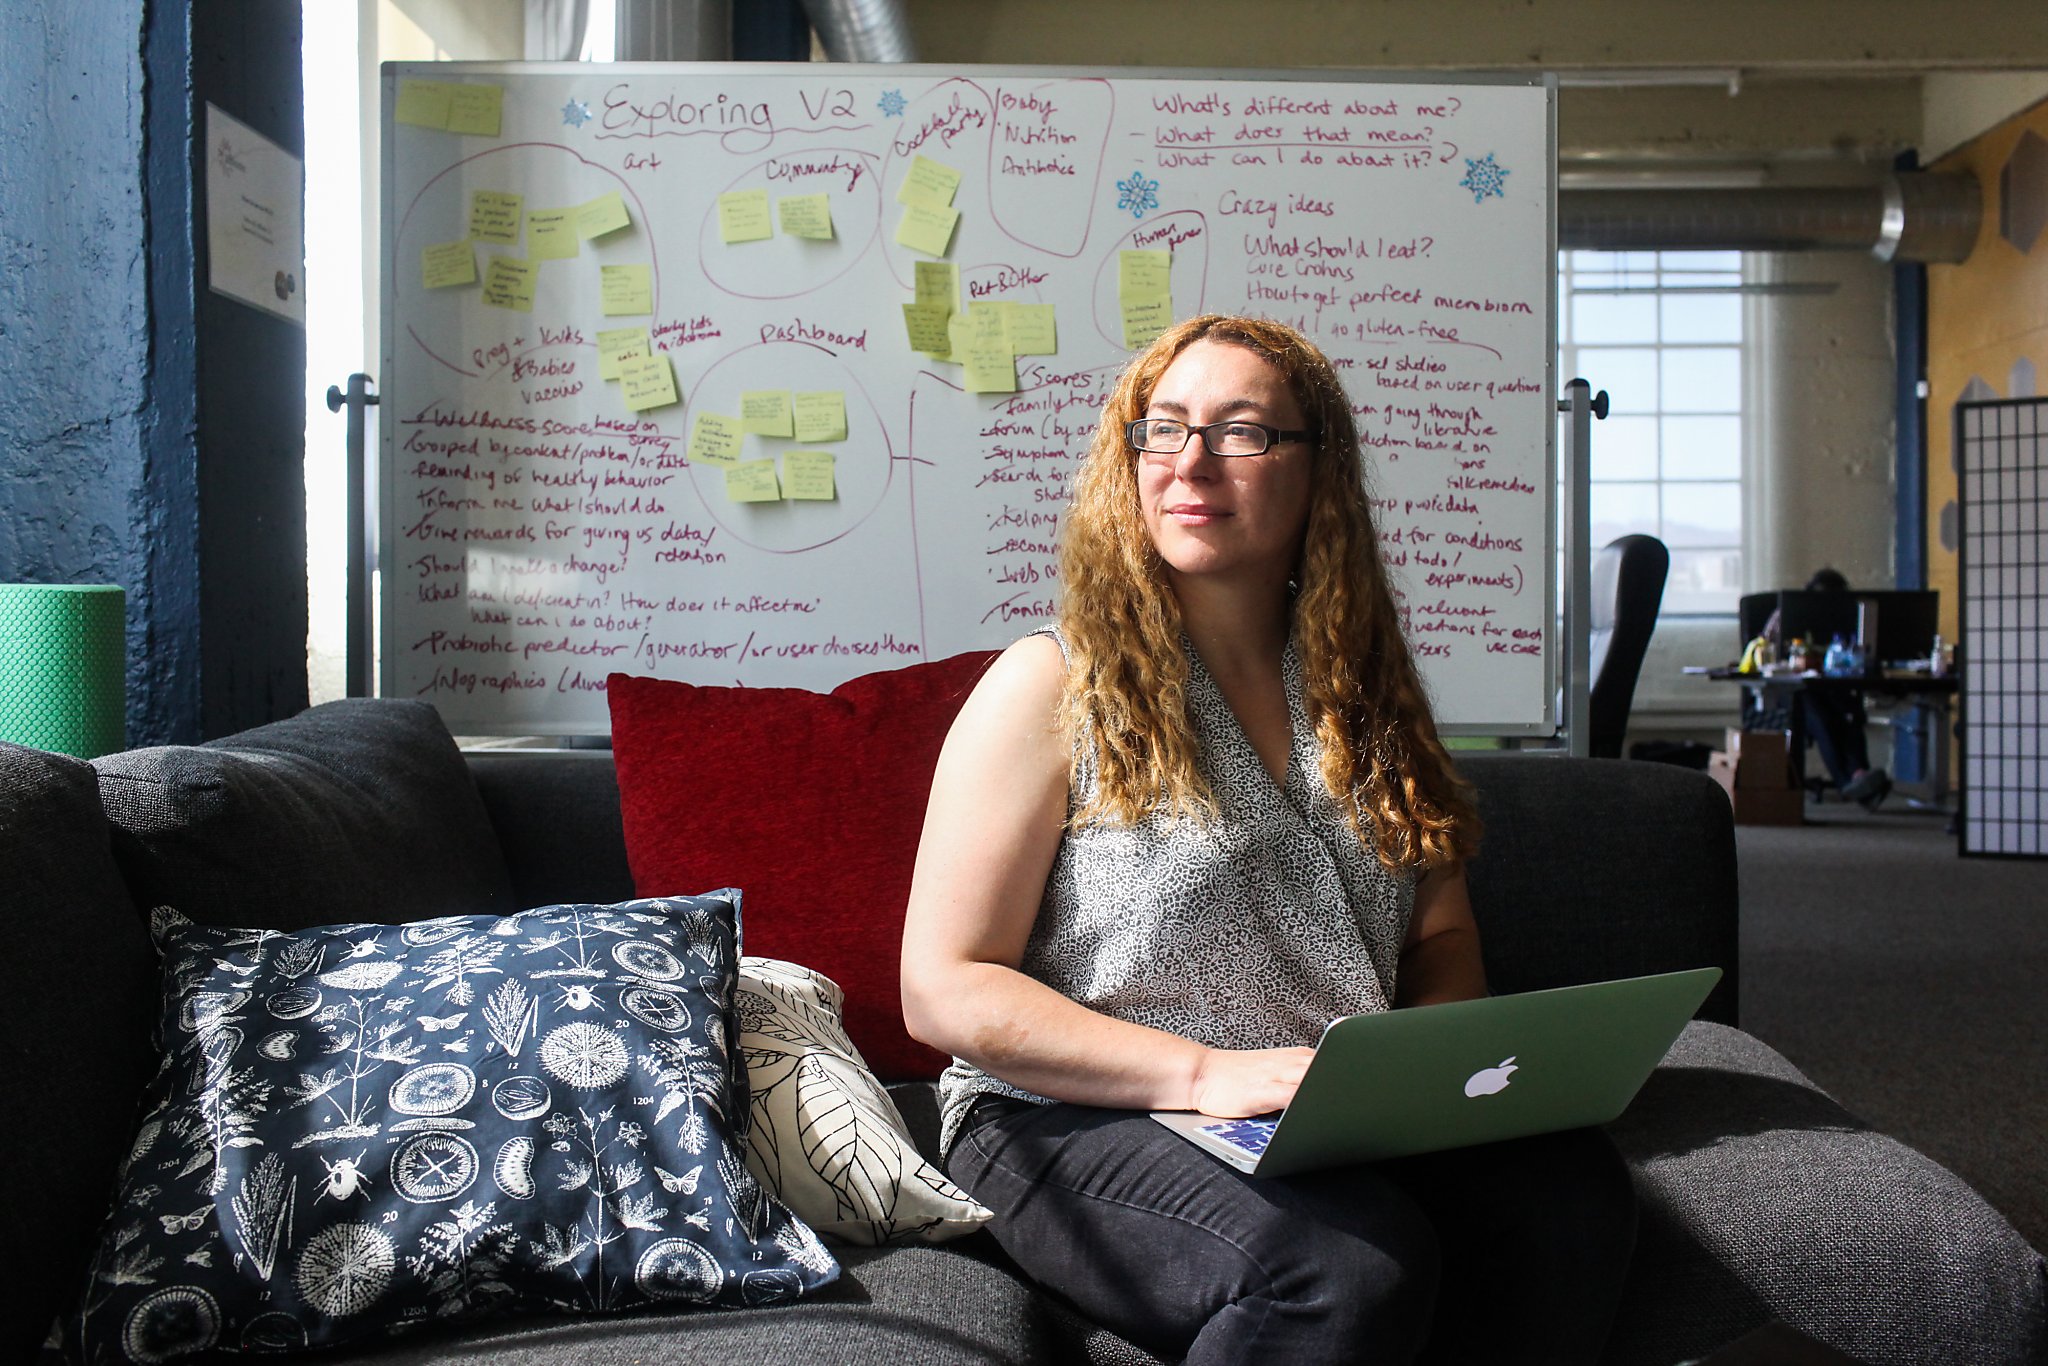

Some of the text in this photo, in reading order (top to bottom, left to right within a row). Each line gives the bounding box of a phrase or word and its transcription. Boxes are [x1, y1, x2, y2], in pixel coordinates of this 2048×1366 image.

[1001, 92, 1058, 123] Baby
[1152, 93, 1462, 118] What's different about me?
[602, 84, 856, 154] Exploring V2
[941, 107, 989, 149] party
[1004, 125, 1077, 145] Nutrition
[1155, 124, 1434, 144] What does that mean?
[1158, 148, 1432, 169] What can I do about it?
[1218, 189, 1335, 228] Crazy ideas
[1245, 234, 1301, 258] What
[1304, 237, 1369, 258] should
[1388, 237, 1434, 258] eat?
[1296, 258, 1355, 281] Crohns
[1247, 280, 1290, 301] How
[1313, 286, 1341, 313] get
[1349, 284, 1423, 313] perfect
[1396, 355, 1447, 372] studies
[1377, 372, 1420, 391] based
[1425, 379, 1442, 389] on
[1446, 381, 1482, 392] user
[1427, 402, 1482, 422] through
[489, 439, 511, 462] by
[1473, 443, 1491, 454] on
[504, 467, 523, 484] of
[532, 469, 599, 497] healthy
[605, 469, 675, 488] behavior
[585, 498, 641, 514] should
[645, 498, 666, 513] do
[1446, 494, 1479, 514] data
[464, 524, 537, 543] rewards
[545, 520, 576, 540] for
[583, 527, 631, 556] giving
[636, 527, 654, 544] us
[1407, 525, 1523, 552] for conditions
[621, 591, 660, 611] How
[666, 596, 705, 612] does
[713, 596, 731, 611] it
[1483, 621, 1508, 636] for
[523, 637, 630, 660] predictor
[777, 643, 820, 658] user
[615, 1019, 630, 1028] 20
[507, 1062, 519, 1070] 12
[482, 1079, 489, 1088] 8
[633, 1096, 655, 1106] 1204
[157, 1158, 180, 1171] 1204
[703, 1196, 713, 1206] 78
[382, 1211, 399, 1224] 20
[752, 1251, 763, 1261] 12
[259, 1291, 272, 1301] 12
